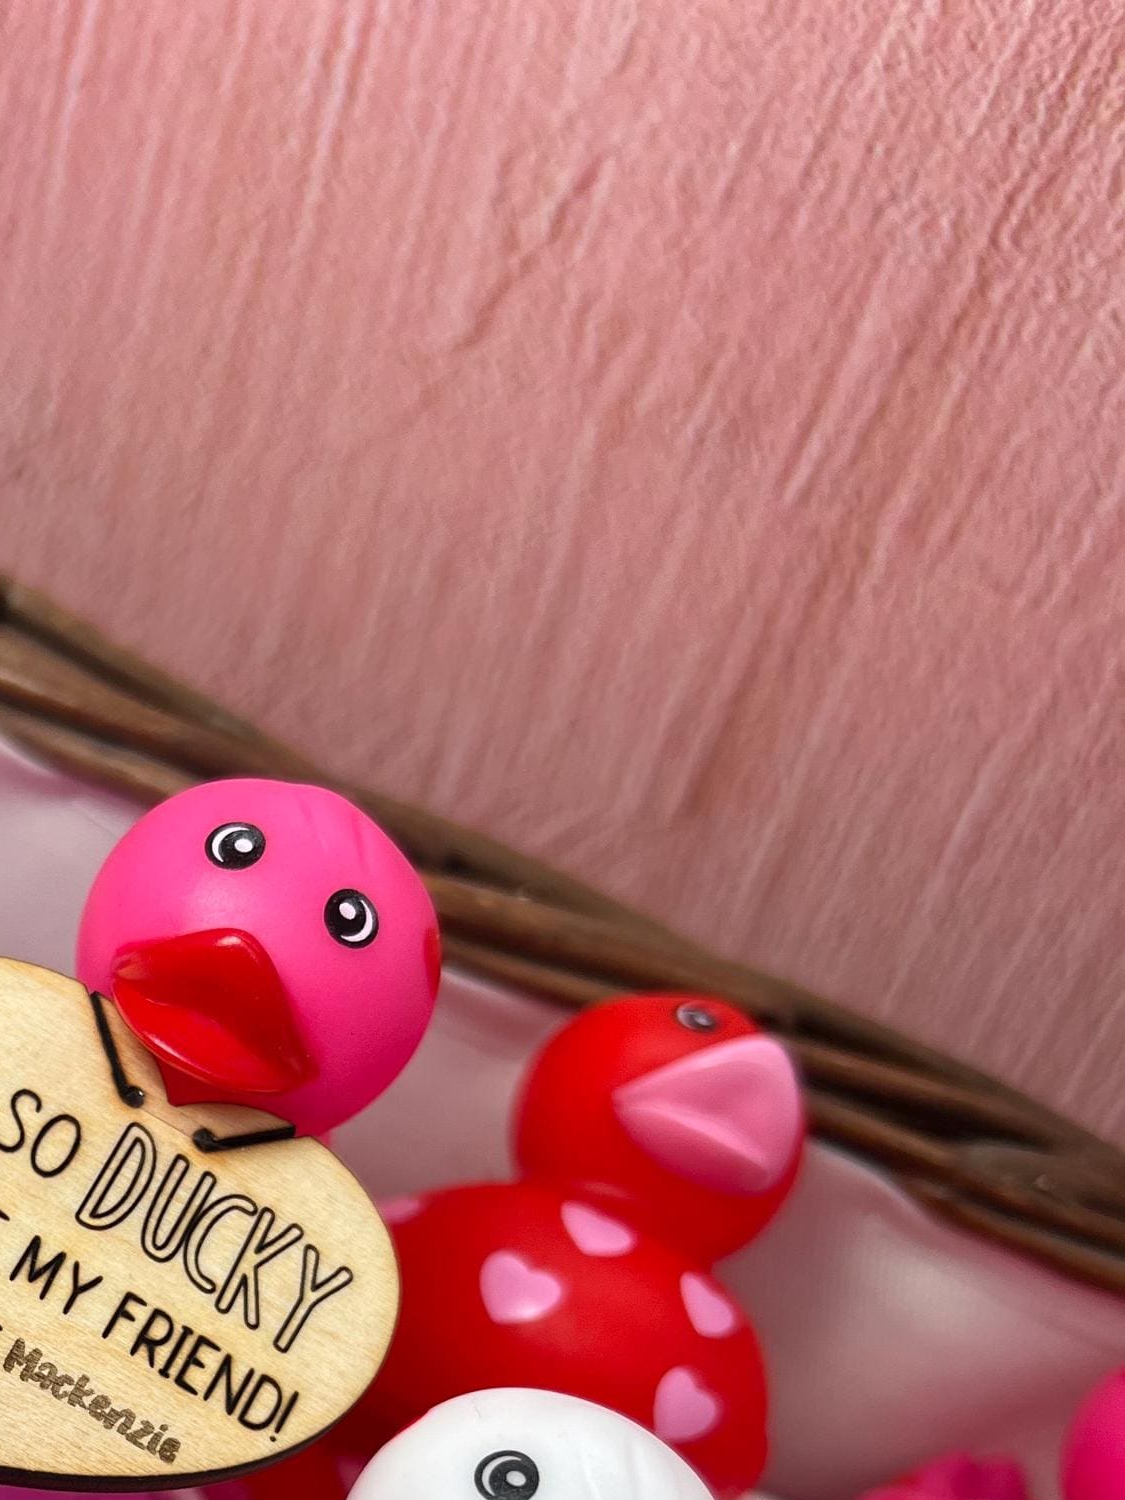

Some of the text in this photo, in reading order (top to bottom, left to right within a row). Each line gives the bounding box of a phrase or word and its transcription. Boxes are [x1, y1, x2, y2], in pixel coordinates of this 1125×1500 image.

[9, 1235, 103, 1315] MY
[102, 1292, 299, 1442] FRIEND!
[75, 1121, 353, 1353] DUCKY
[2, 1337, 181, 1464] Mackenzie
